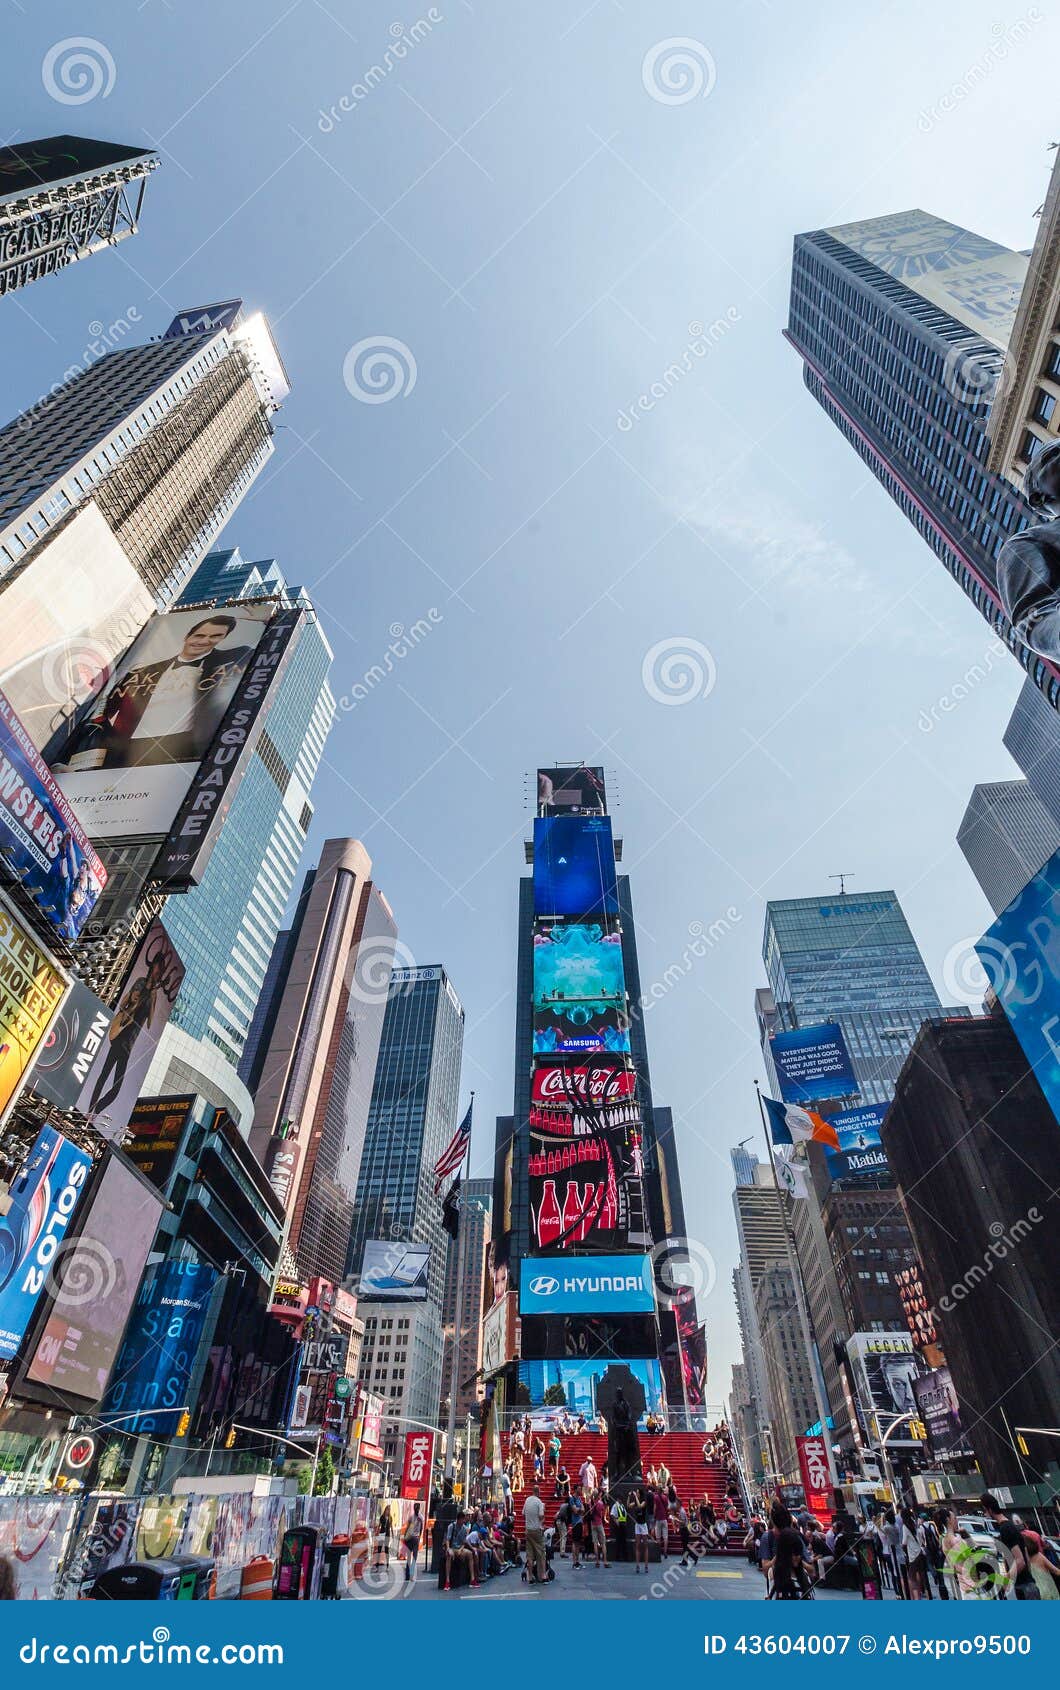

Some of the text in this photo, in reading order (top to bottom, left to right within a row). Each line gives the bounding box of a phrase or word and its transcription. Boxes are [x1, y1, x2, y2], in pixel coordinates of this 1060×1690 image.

[243, 624, 291, 700] TIMES
[180, 710, 250, 836] SQUARE
[34, 758, 52, 786] LAST
[49, 781, 85, 847] PERFORMANCE
[72, 1011, 110, 1084] NEW
[563, 1039, 600, 1047] SAMSUNG
[818, 1043, 837, 1051] KNEW
[781, 1055, 806, 1064] MATILDA
[786, 1069, 806, 1078] KNOW
[806, 1067, 822, 1075] HOW
[803, 1060, 816, 1068] JUST
[861, 1112, 876, 1120] AND
[37, 1161, 88, 1265] SOLO
[563, 1276, 644, 1293] HYUNDAI
[411, 1437, 430, 1483] tkts
[804, 1441, 826, 1489] tkts
